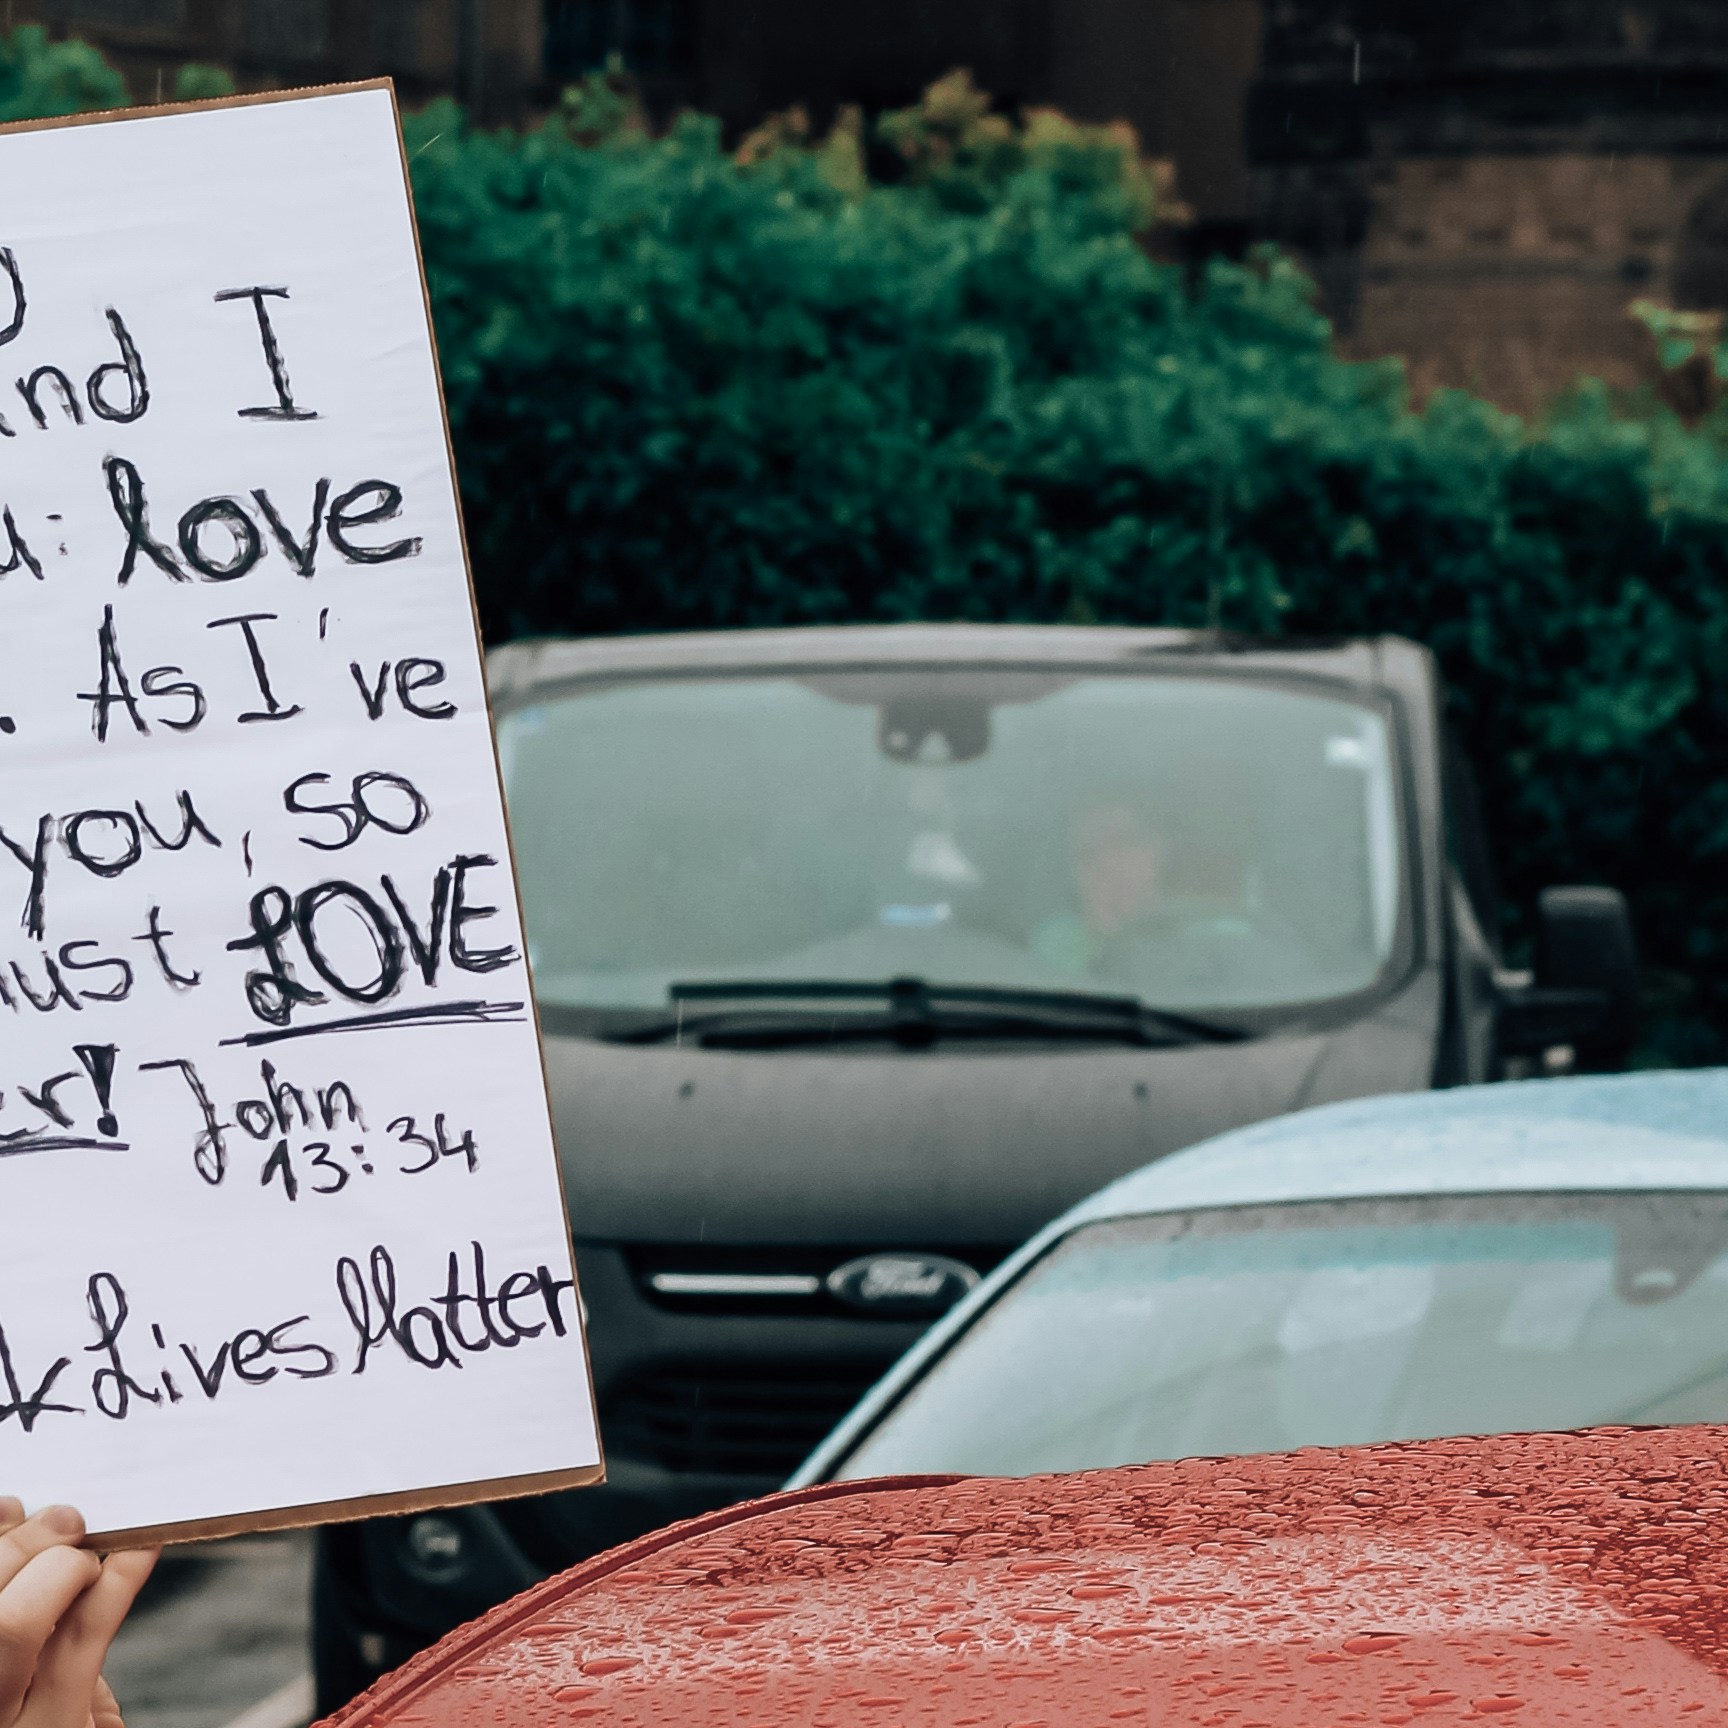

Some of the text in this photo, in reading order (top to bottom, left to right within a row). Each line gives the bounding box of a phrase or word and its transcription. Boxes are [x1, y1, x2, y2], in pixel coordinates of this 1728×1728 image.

[214, 286, 318, 422] I
[101, 455, 424, 586] love
[76, 603, 207, 745] As
[206, 607, 460, 724] I've
[283, 771, 431, 851] so
[225, 853, 518, 1027] LOVE
[138, 1058, 371, 1186] John
